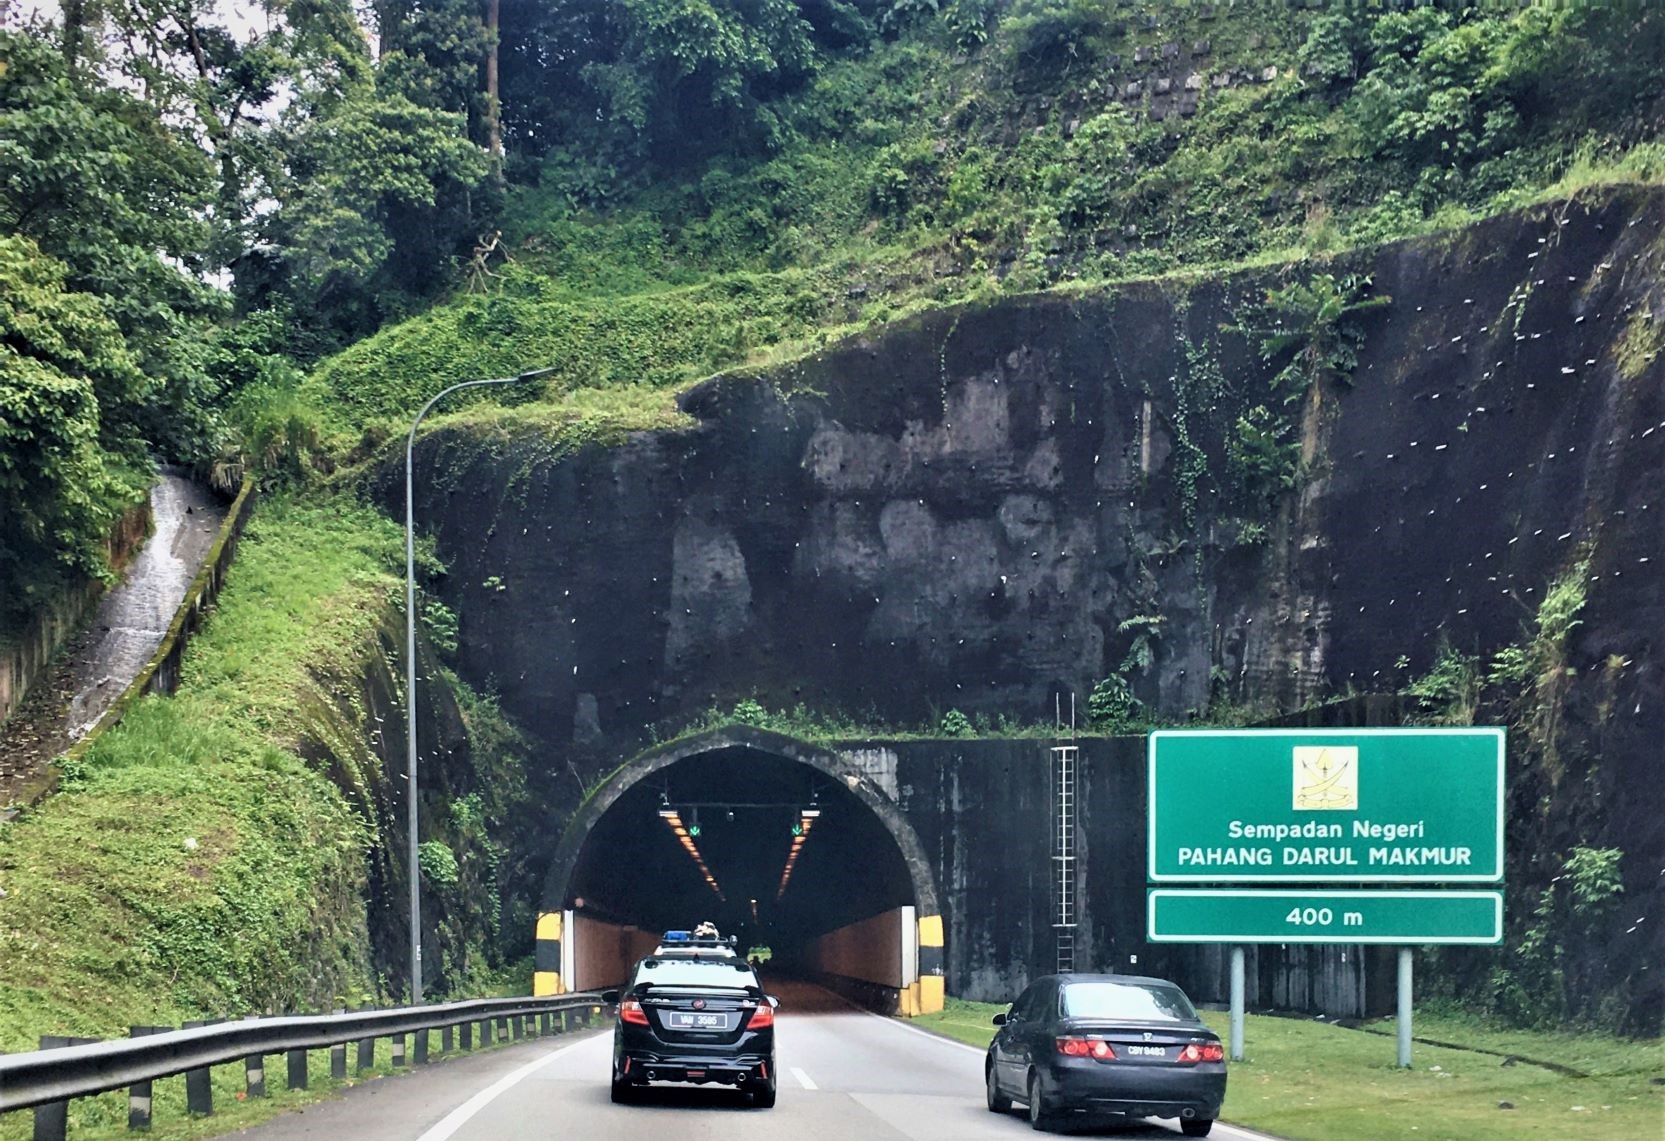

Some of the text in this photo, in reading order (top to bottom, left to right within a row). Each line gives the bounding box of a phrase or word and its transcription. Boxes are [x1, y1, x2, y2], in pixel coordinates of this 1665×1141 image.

[1228, 820, 1424, 841] Sempadan Negeri
[1178, 847, 1471, 866] PAHANG DARUL MAKMUR
[1285, 907, 1363, 926] 400 m
